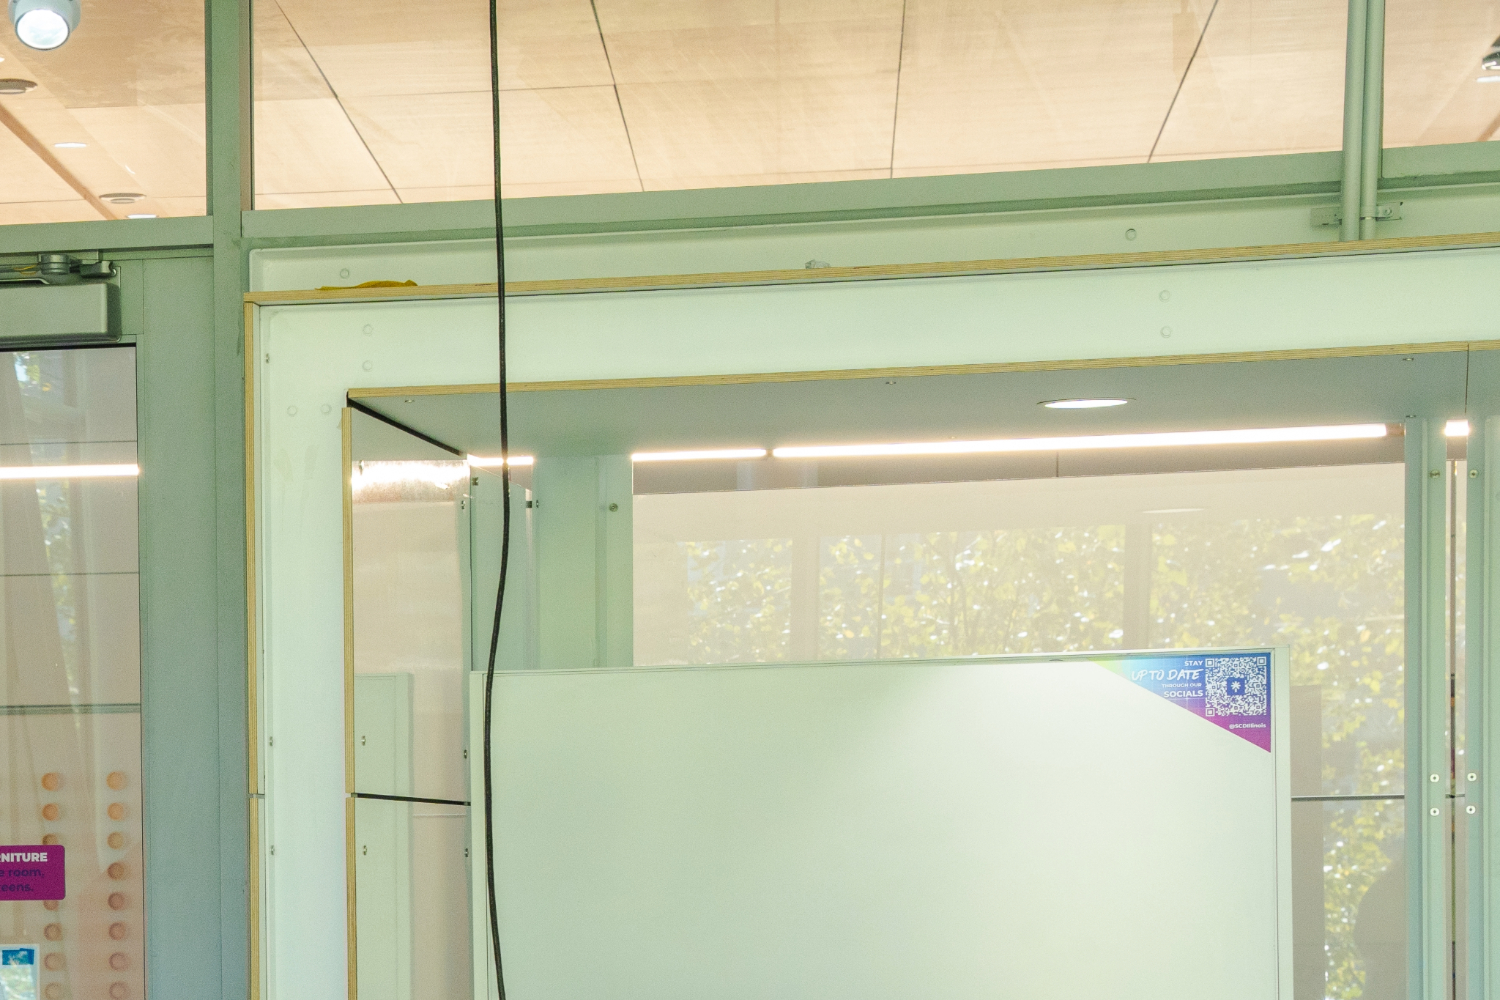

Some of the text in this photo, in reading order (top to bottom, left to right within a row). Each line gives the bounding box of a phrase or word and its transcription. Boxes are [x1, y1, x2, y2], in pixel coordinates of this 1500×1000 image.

[1131, 668, 1204, 681] UP TO DATE
[1164, 690, 1204, 698] SOCIALS
